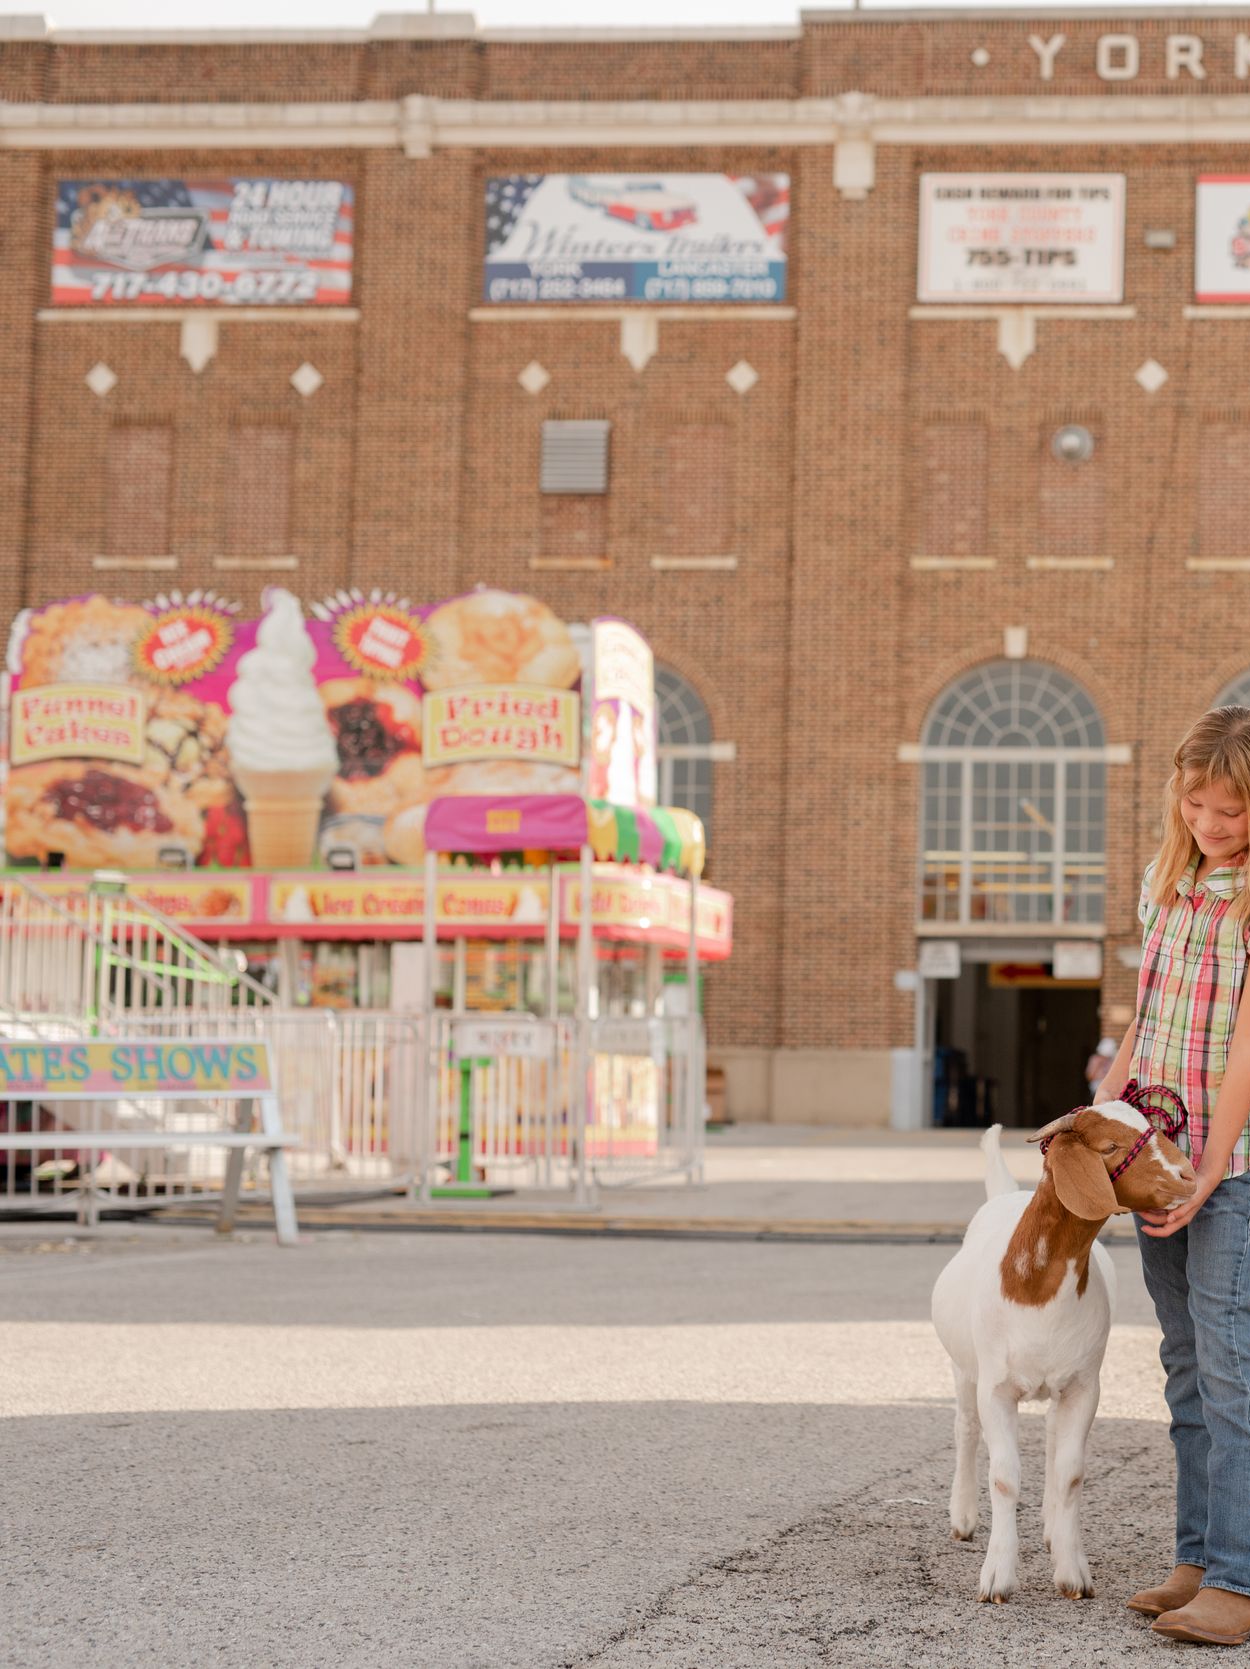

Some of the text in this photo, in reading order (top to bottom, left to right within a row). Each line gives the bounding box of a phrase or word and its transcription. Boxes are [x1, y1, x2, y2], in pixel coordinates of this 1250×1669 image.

[445, 695, 560, 721] Fried
[440, 724, 564, 751] Dough
[110, 1046, 258, 1081] SHOWS
